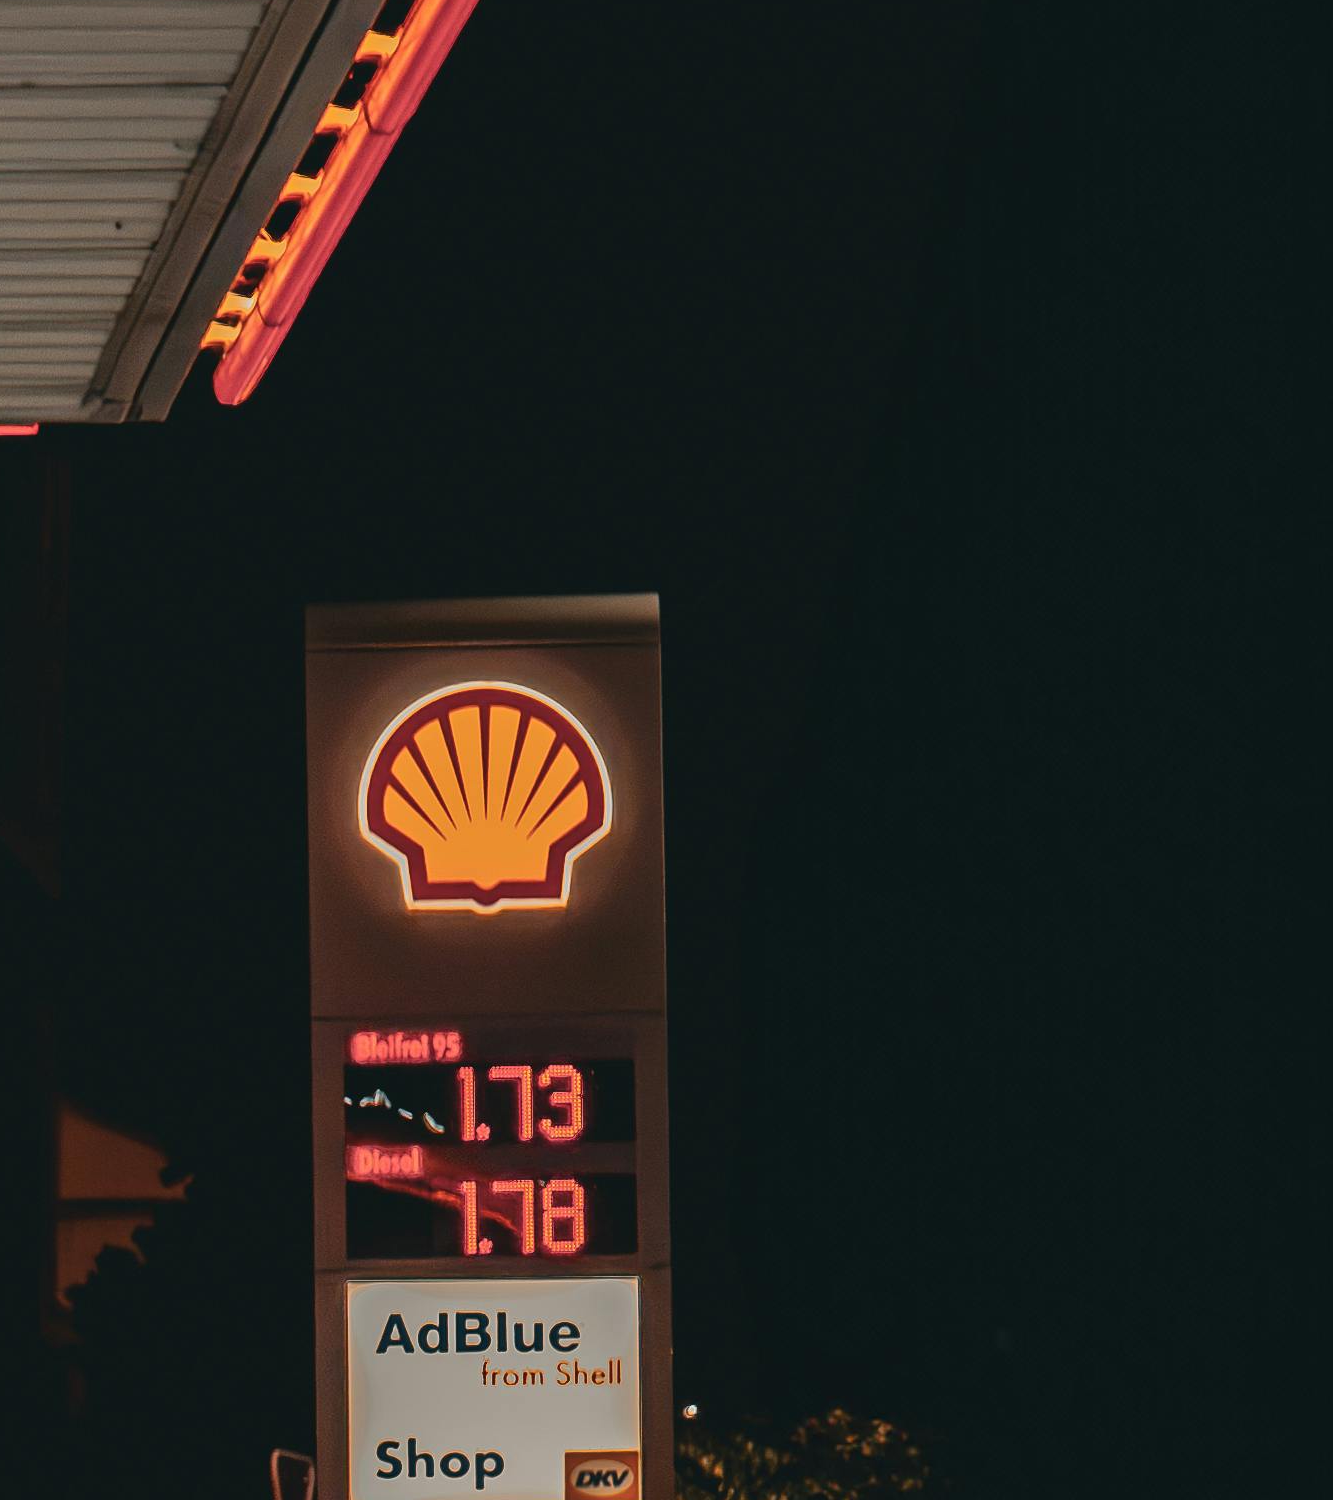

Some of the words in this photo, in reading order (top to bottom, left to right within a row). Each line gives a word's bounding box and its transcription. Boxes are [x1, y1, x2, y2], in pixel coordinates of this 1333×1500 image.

[433, 1032, 461, 1061] 95
[458, 1066, 583, 1141] 1.73
[352, 1146, 422, 1176] Diesel
[462, 1180, 584, 1255] 1.78
[376, 1311, 581, 1354] AdBlue
[481, 1359, 544, 1386] from
[556, 1358, 622, 1386] Shell
[376, 1438, 504, 1490] Shop
[575, 1468, 629, 1489] DKV
